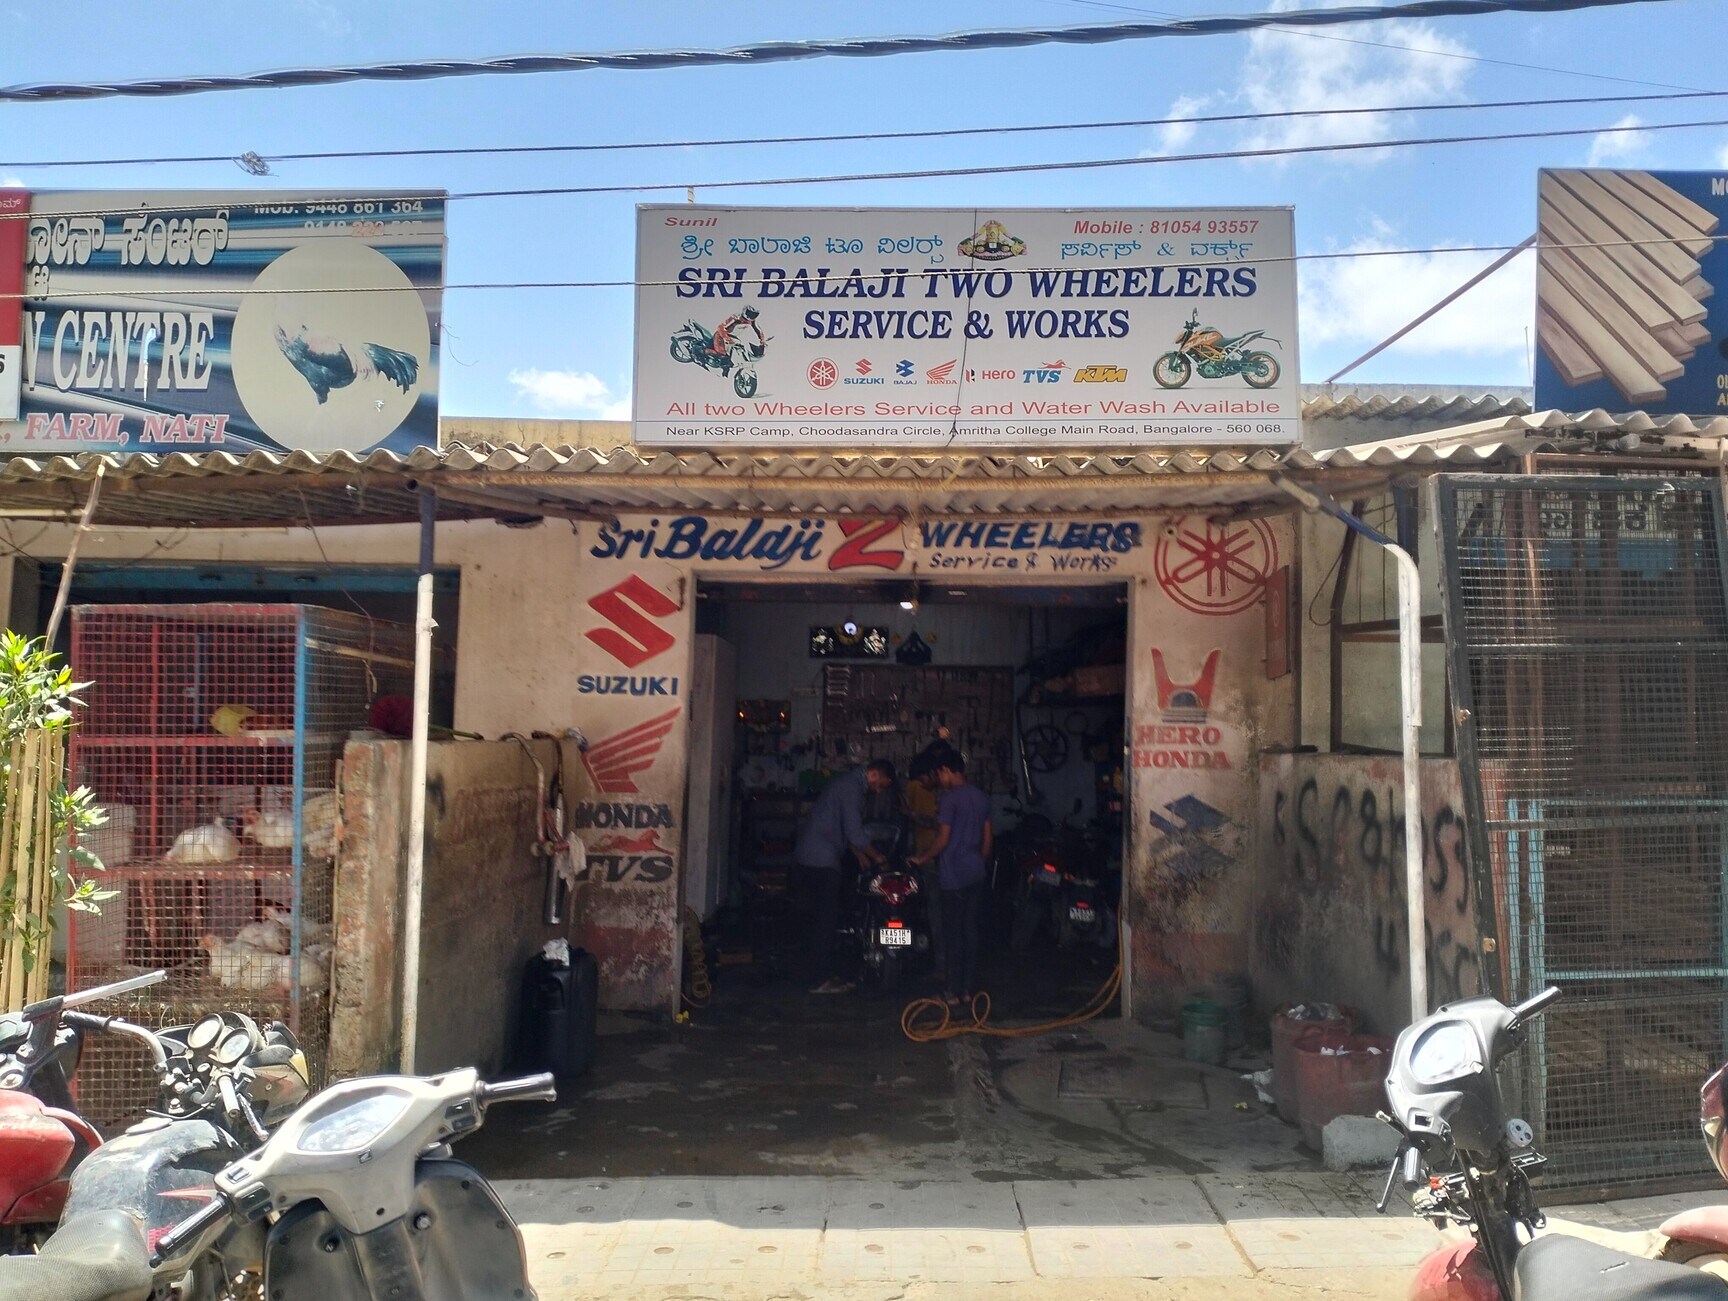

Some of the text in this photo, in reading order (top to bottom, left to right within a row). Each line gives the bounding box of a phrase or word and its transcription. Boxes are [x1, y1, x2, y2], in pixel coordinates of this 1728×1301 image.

[390, 199, 424, 214] 364
[664, 216, 718, 227] Sunil
[1074, 220, 1133, 234] Mobile
[1150, 220, 1202, 234] 81054
[1207, 220, 1260, 234] 93557
[1156, 242, 1175, 256] &
[676, 266, 1257, 298] SRI BALAJI TWO WHEELERS
[802, 309, 1130, 340] SERVICE & WORKS
[53, 310, 215, 391] CENTRE
[844, 377, 885, 385] SUZUKI
[1022, 369, 1062, 384] TVS
[1073, 365, 1129, 383] KTM
[666, 400, 1280, 417] All two Wheelers Service and Water Wash Available
[24, 412, 130, 447] FARM,
[139, 414, 230, 443] NATI
[666, 426, 700, 436] Near
[703, 426, 746, 436] KSRP
[749, 426, 794, 438] Camp,
[798, 425, 899, 436] Choodasandra
[902, 425, 945, 437] Circle,
[948, 425, 1001, 436] Amritha
[1005, 425, 1057, 438] College
[1061, 425, 1094, 435] Main
[1098, 424, 1139, 436] Road,
[1143, 424, 1213, 437] Bangalore
[1226, 424, 1252, 434] 560
[1255, 424, 1285, 434] 068.
[590, 517, 660, 559] Sri
[655, 516, 825, 570] Balaji
[918, 520, 1143, 553] WHEELERS
[929, 552, 1019, 569] Service
[1050, 553, 1118, 572] Works
[576, 675, 679, 696] SUZUKI
[1135, 725, 1222, 746] HERO
[1132, 750, 1232, 769] HONDA
[574, 855, 674, 882] TVS
